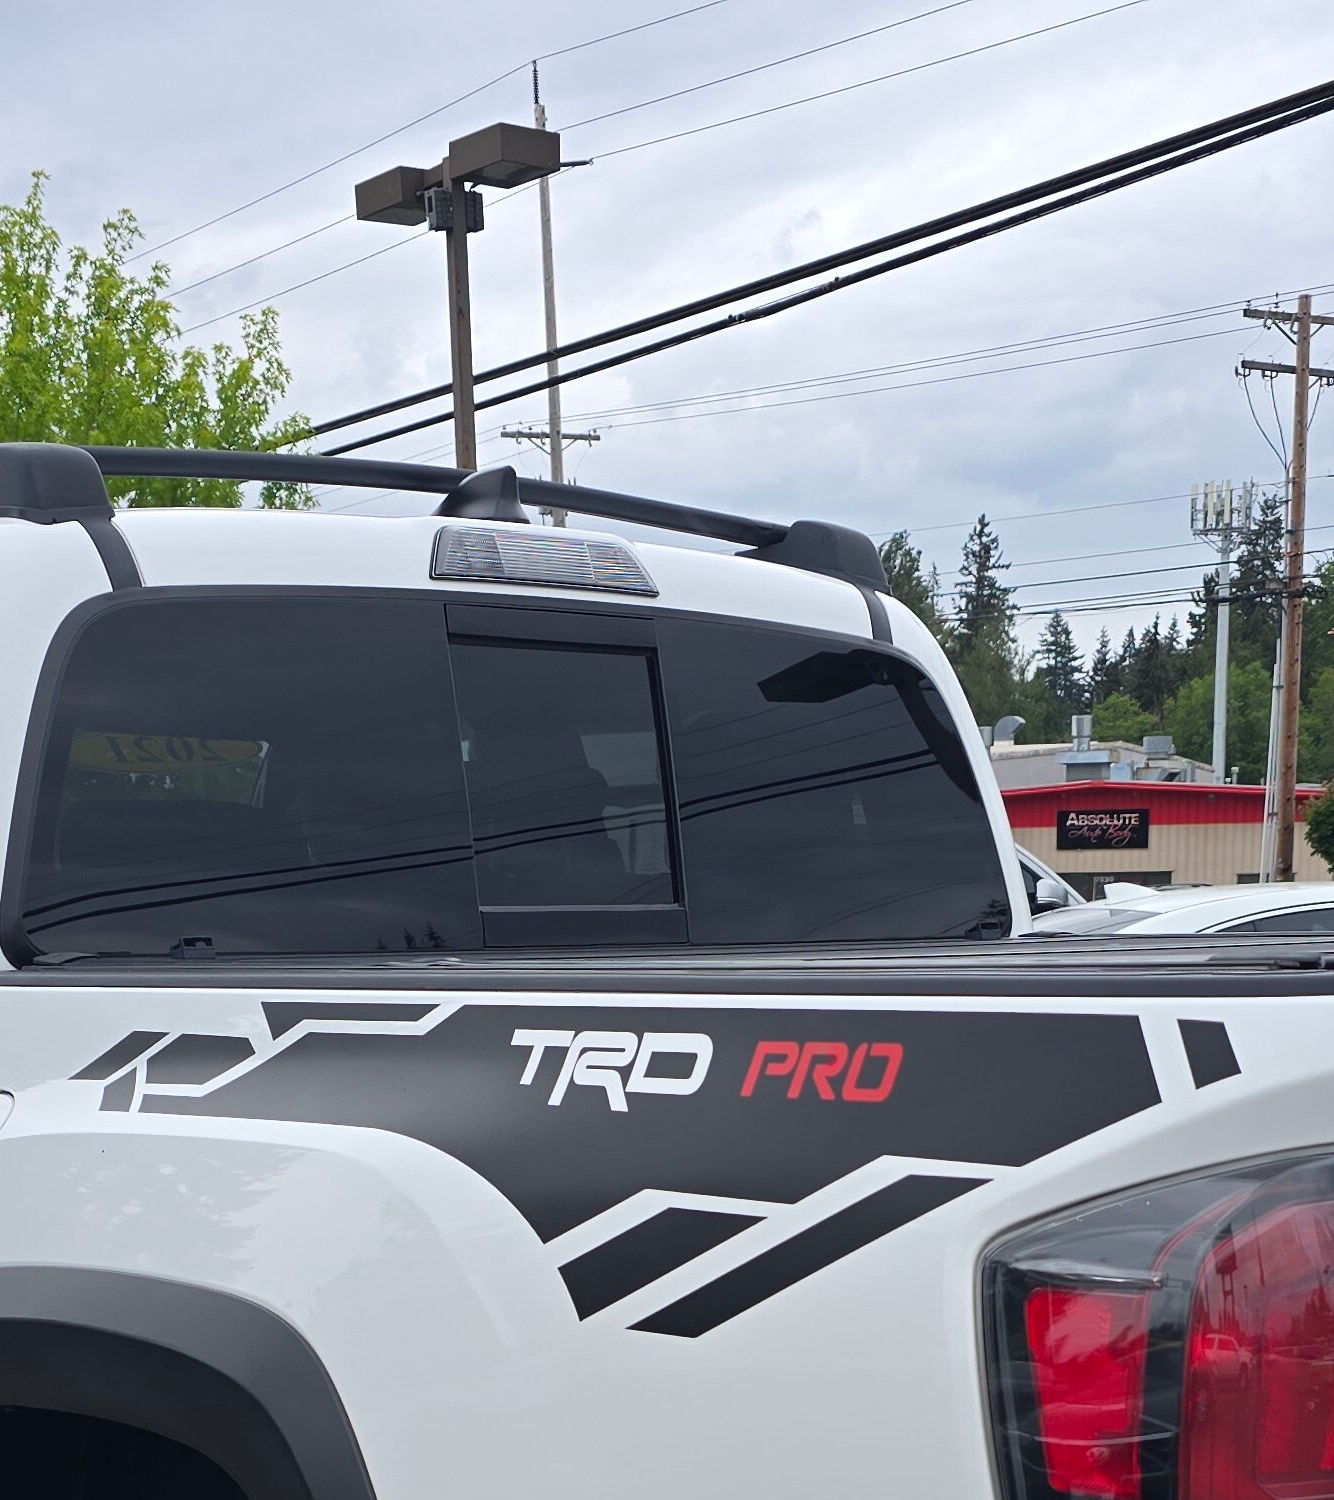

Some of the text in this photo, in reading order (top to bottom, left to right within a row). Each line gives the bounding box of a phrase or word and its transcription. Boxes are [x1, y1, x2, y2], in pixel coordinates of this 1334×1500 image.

[1066, 812, 1140, 826] ABSOLUTE
[1068, 824, 1137, 847] Auto Body
[511, 1029, 904, 1112] TRD PRO
